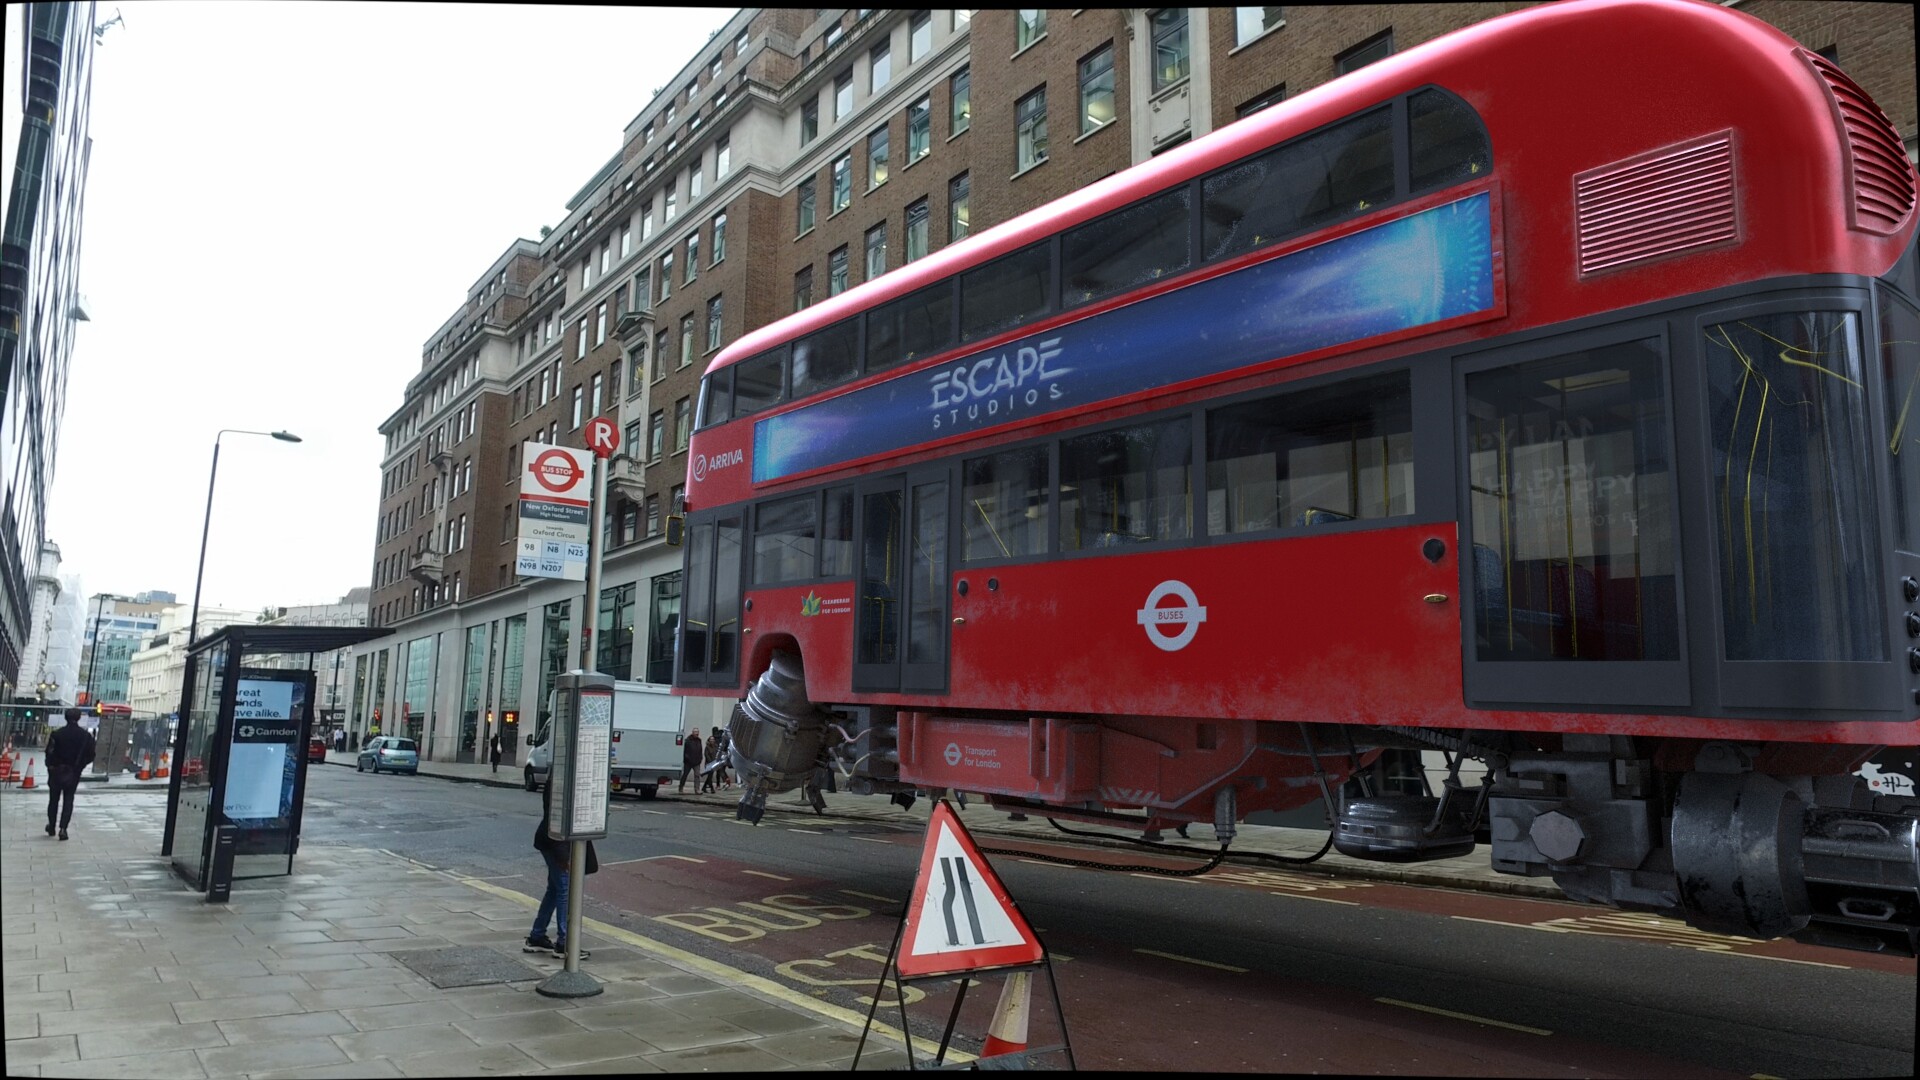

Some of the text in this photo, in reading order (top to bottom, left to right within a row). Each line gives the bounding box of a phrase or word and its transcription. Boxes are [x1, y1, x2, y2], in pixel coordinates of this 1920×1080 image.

[929, 337, 1076, 409] ESCAPE
[933, 383, 1064, 429] STUDIOS
[595, 422, 613, 449] R
[708, 448, 744, 472] ARRIVA
[541, 465, 573, 476] BUS STOP
[542, 505, 565, 513] Oxford
[565, 507, 584, 516] Street
[532, 529, 576, 539] Oxford Circus
[524, 543, 535, 551] 98
[568, 548, 584, 557] N25
[519, 562, 537, 570] N98
[541, 564, 562, 572] N207
[1158, 611, 1184, 620] BUSES
[239, 689, 261, 697] reat
[235, 709, 282, 718] ave alike.
[255, 727, 297, 736] Camden
[964, 745, 997, 757] Transport
[964, 757, 1001, 769] for London
[651, 893, 871, 943] BUS
